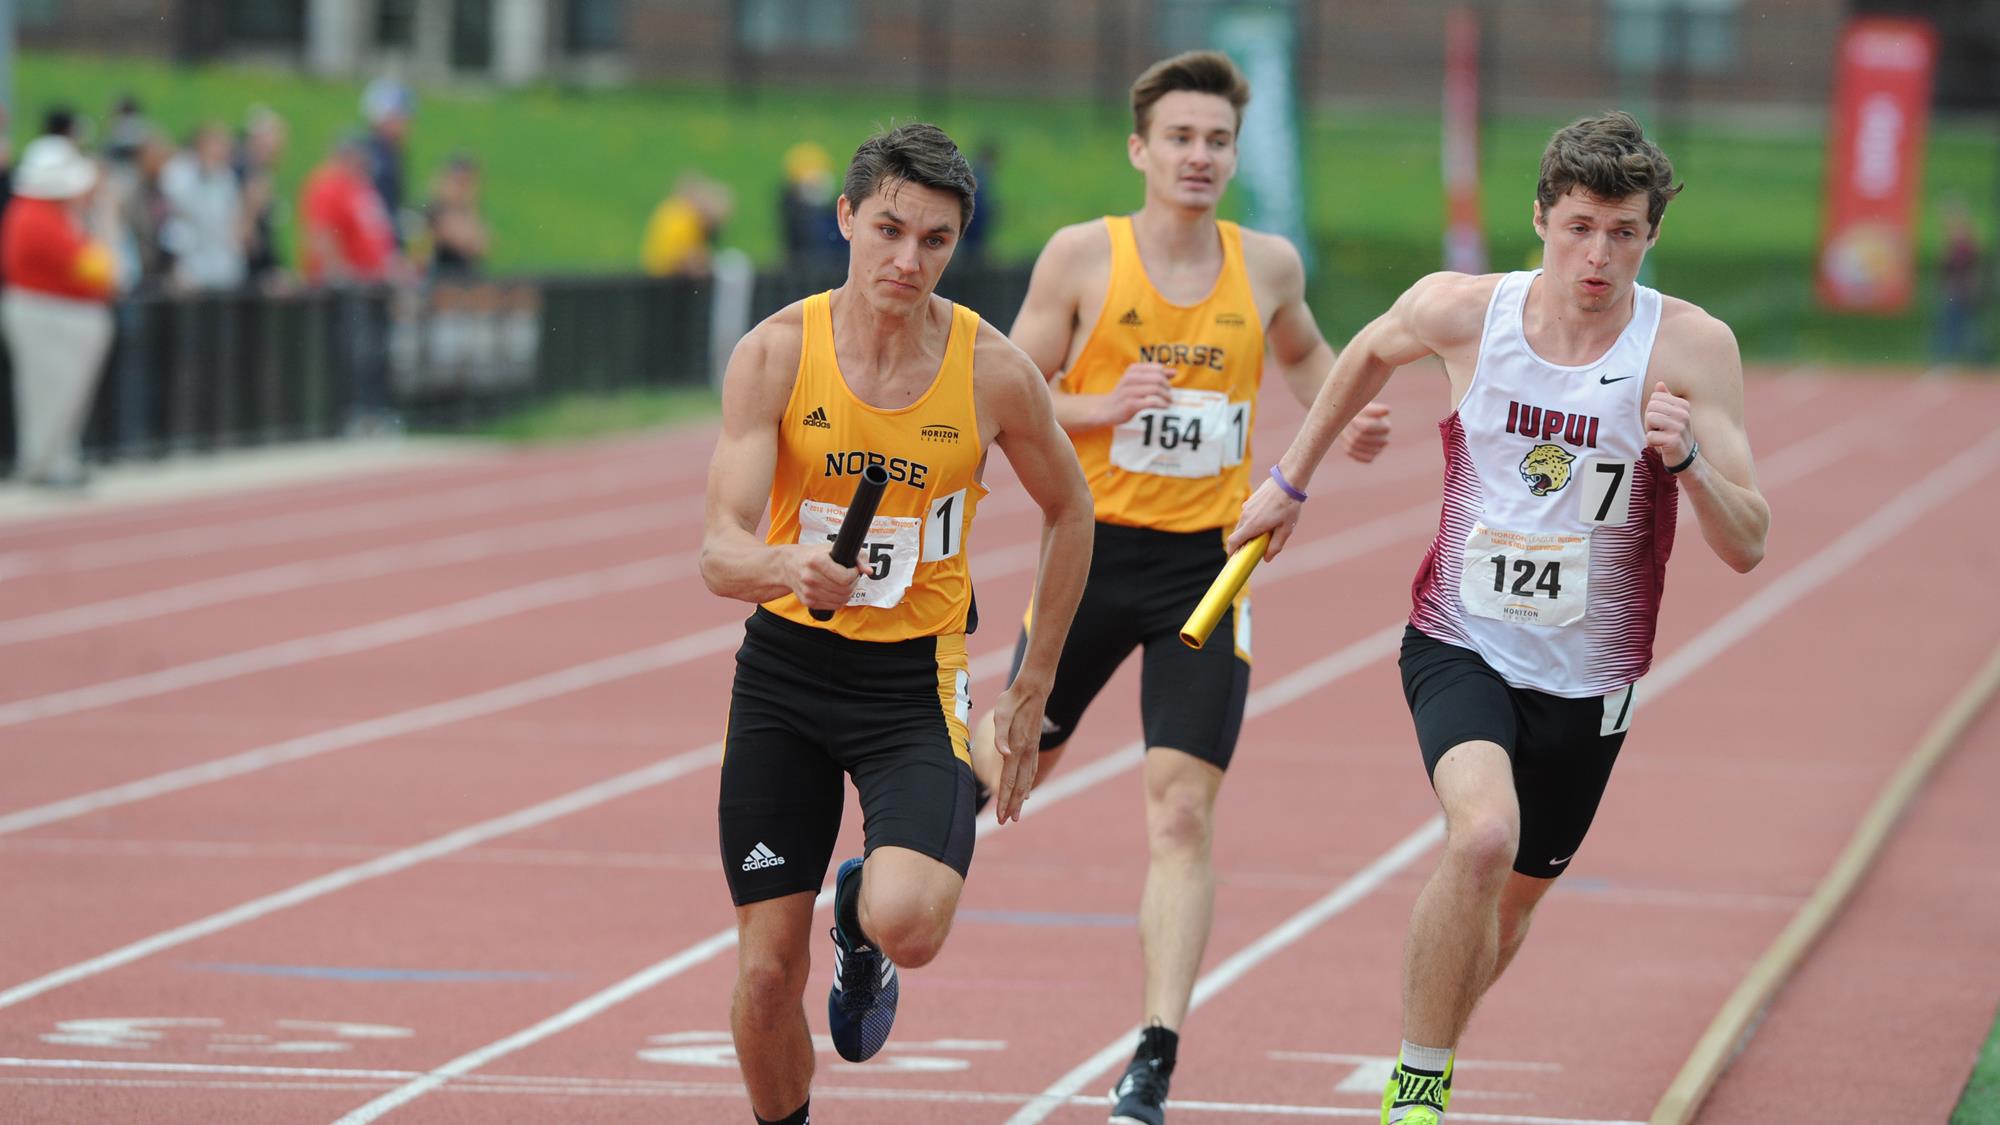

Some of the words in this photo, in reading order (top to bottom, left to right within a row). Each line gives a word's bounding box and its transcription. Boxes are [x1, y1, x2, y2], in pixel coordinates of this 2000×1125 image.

[1139, 345, 1224, 371] NORSE
[802, 418, 831, 429] adidas
[921, 429, 959, 439] HORIZON
[1140, 413, 1203, 451] 154
[1232, 407, 1244, 460] 1
[1505, 400, 1599, 449] IUPUI
[1594, 463, 1626, 521] 7
[936, 496, 954, 556] 1
[1490, 554, 1562, 600] 124
[1503, 607, 1539, 618] HORIZON
[741, 856, 786, 872] adidas
